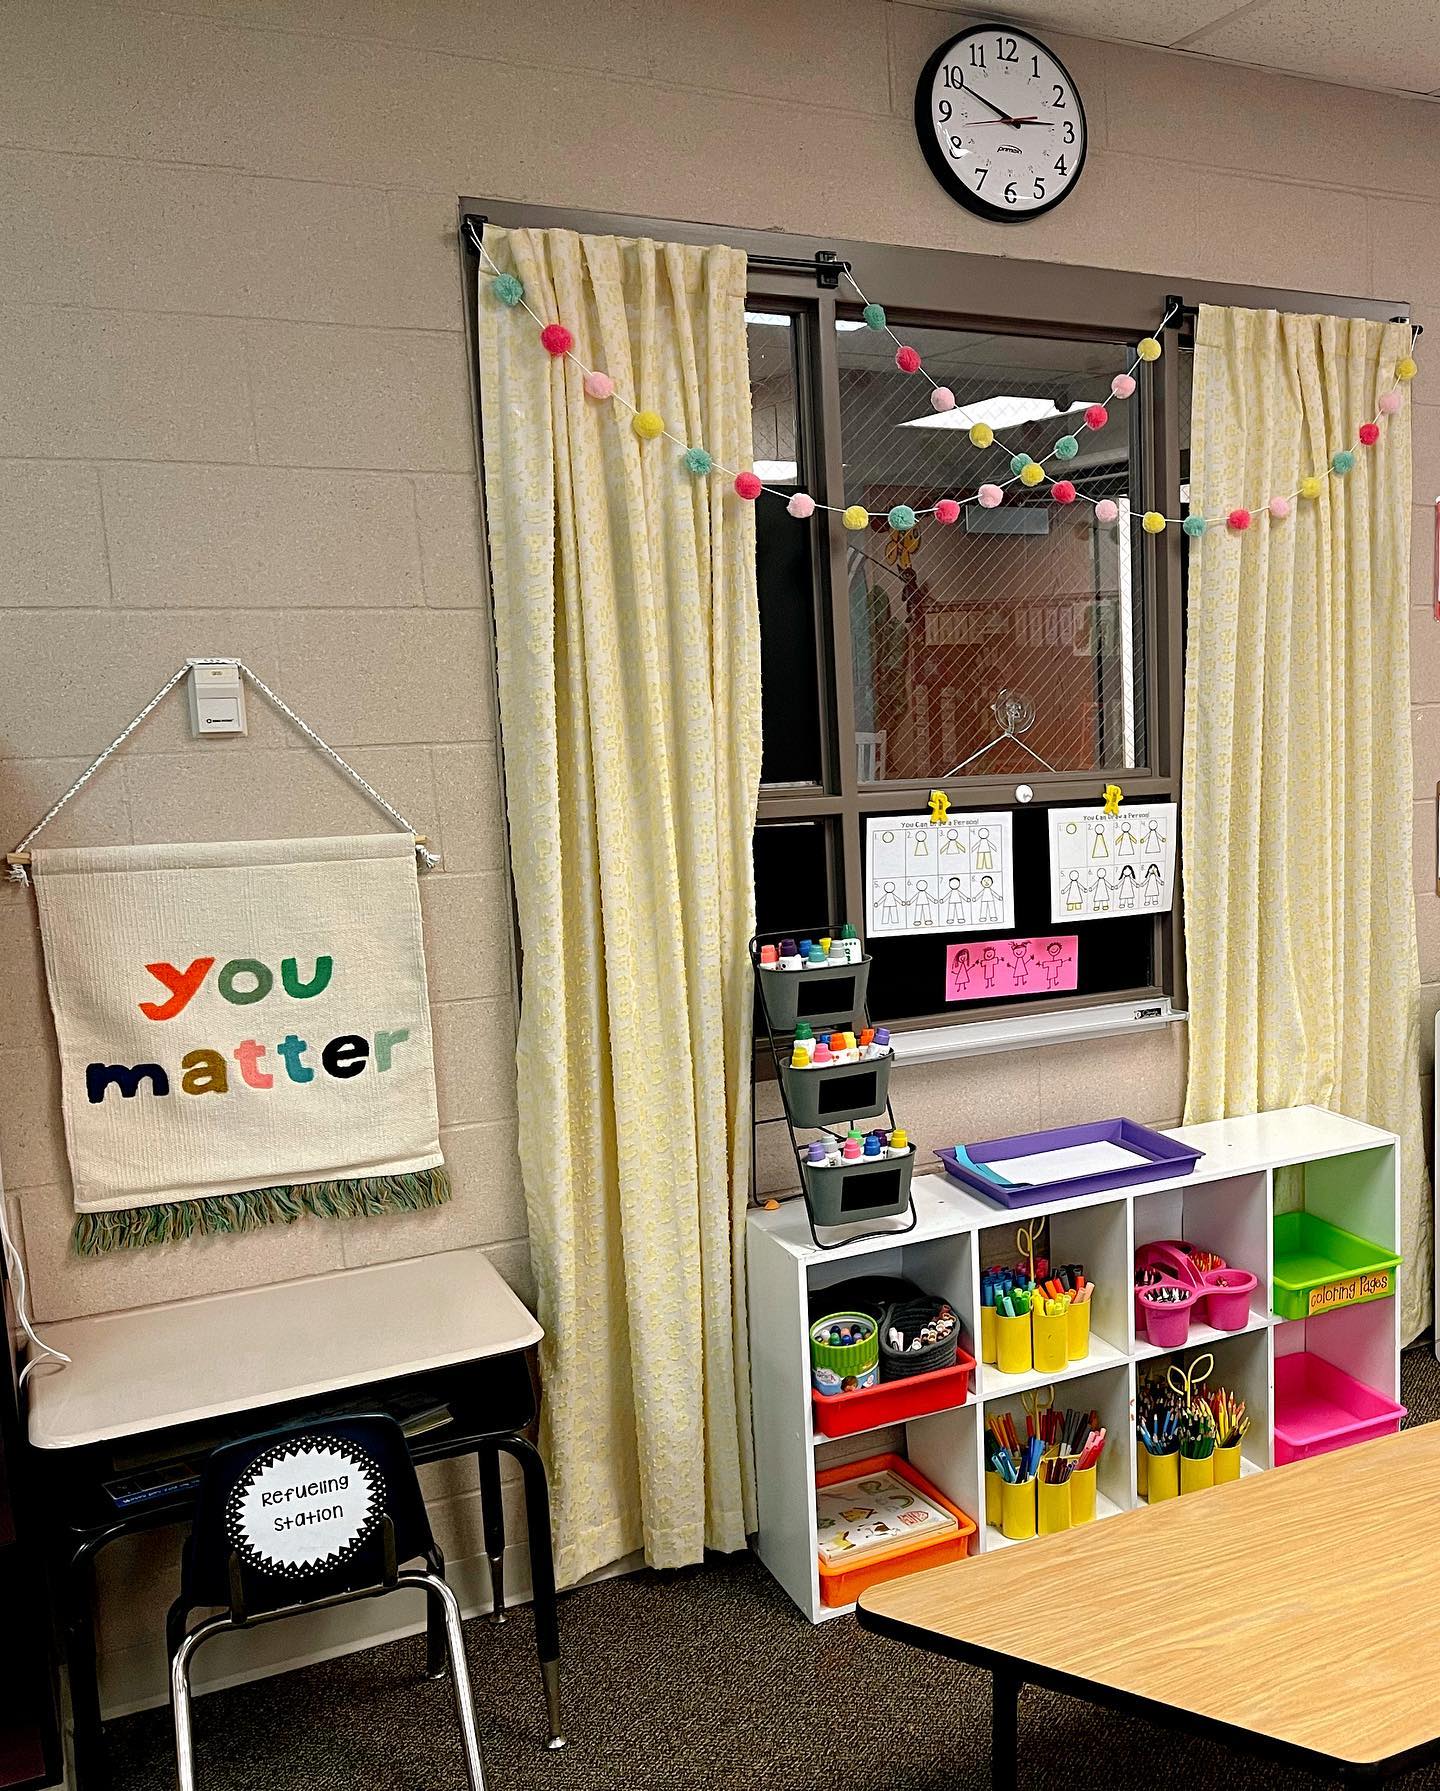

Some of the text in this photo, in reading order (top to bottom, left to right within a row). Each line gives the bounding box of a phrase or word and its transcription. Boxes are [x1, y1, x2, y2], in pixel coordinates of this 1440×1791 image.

[969, 43, 987, 69] 11
[995, 37, 1019, 63] 12
[943, 64, 964, 90] 10
[1031, 55, 1041, 79] 1
[1052, 84, 1066, 109] 2
[938, 99, 952, 123] 9
[1062, 120, 1075, 145] 3
[949, 135, 962, 160] 8
[1053, 153, 1068, 177] 4
[974, 167, 989, 191] 7
[1033, 177, 1045, 200] 5
[1004, 181, 1018, 204] 6
[137, 955, 333, 1021] you
[85, 1028, 410, 1104] matter
[1360, 1275, 1388, 1296] Pages
[261, 1475, 349, 1507] Refueling
